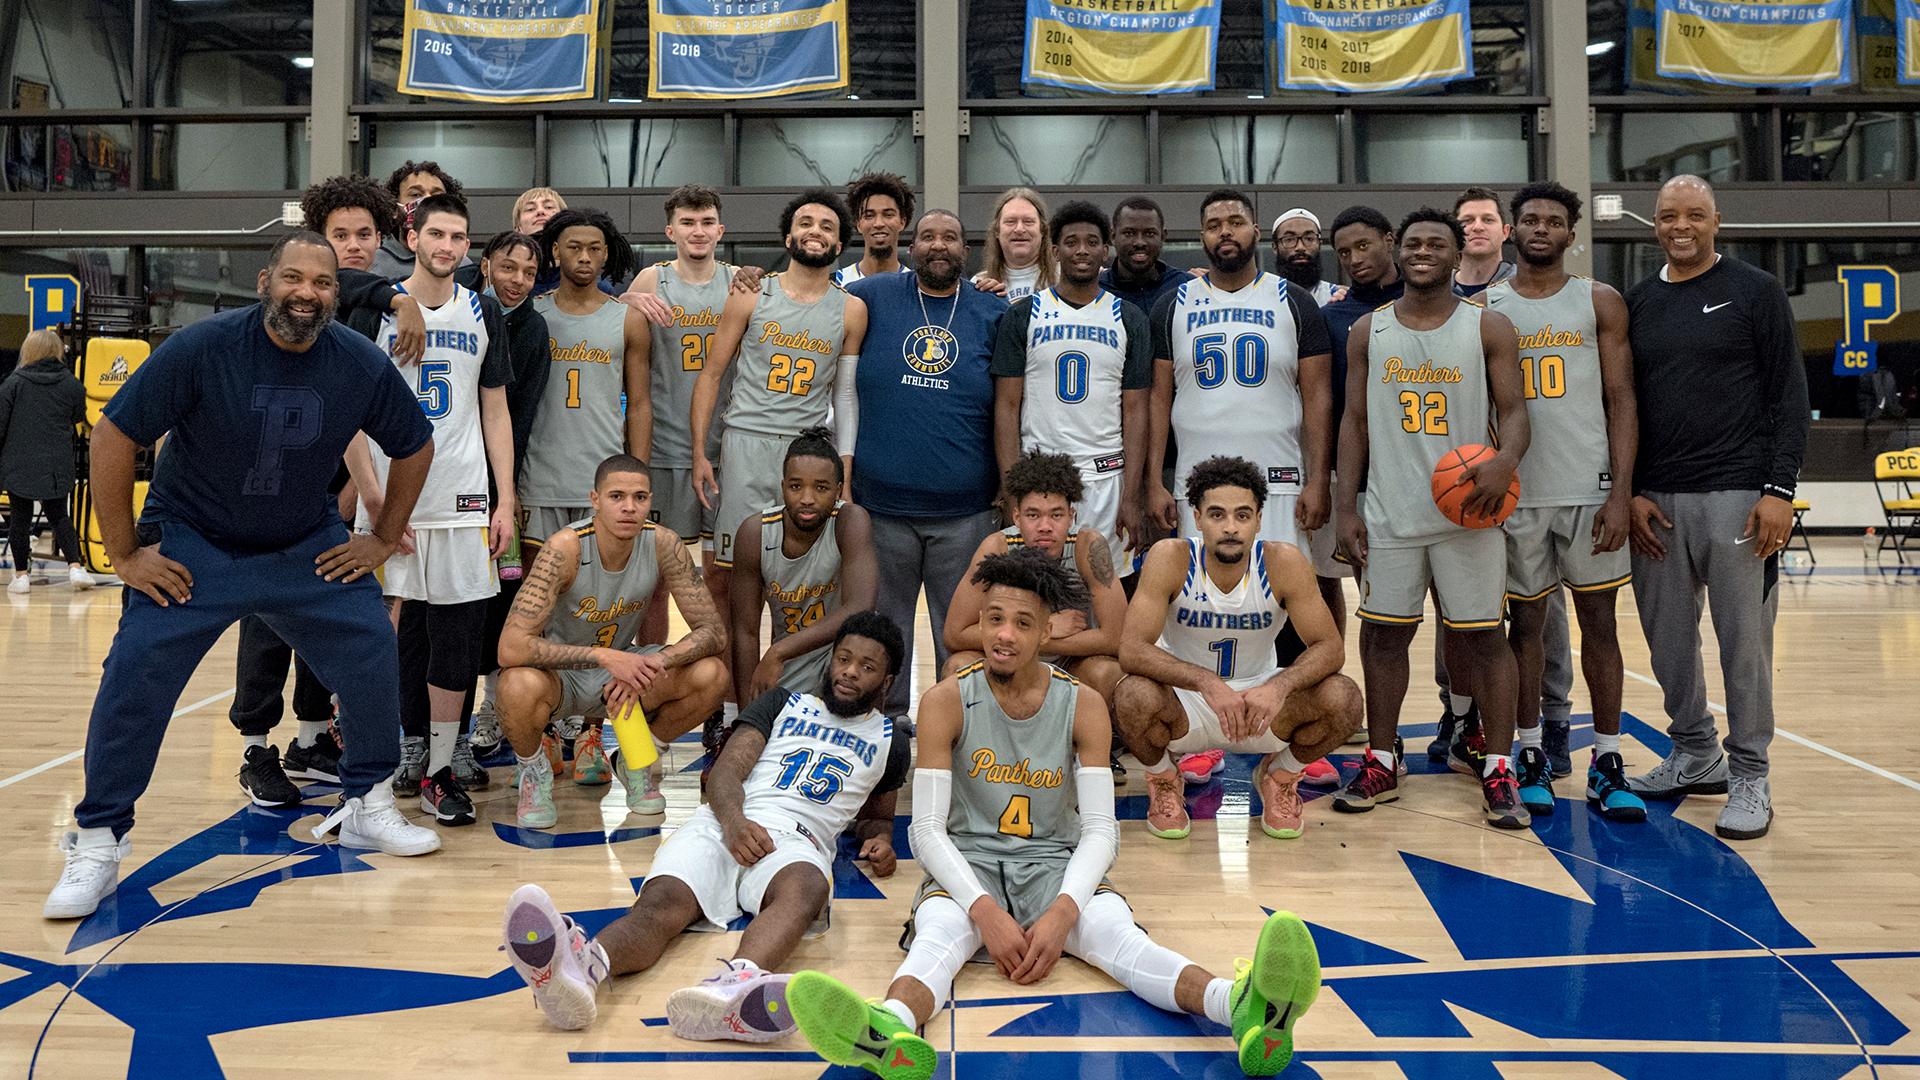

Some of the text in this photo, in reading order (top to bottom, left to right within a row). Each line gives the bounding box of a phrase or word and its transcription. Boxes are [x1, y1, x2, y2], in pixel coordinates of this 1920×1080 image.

[447, 3, 557, 18] BASKETBALL
[714, 2, 780, 15] SOCCER
[1051, 6, 1194, 28] REGION CHAMPIONS
[1302, 11, 1371, 27] TOURNAMENT
[1678, 0, 1826, 21] REGION CHAMPIONS
[419, 14, 584, 35] TOURNAMENT APPEARANCES
[676, 12, 820, 32] PLAYOFF APPEARANCES
[1678, 23, 1705, 38] 2017
[424, 39, 453, 56] 2015
[1046, 30, 1073, 45] 2014
[1300, 36, 1369, 53] 2014 2017
[672, 43, 701, 57] 2018
[1045, 52, 1072, 67] 2018
[1301, 56, 1370, 74] 2016 2018
[667, 305, 723, 328] Panthe
[1837, 265, 1901, 346] P
[1186, 308, 1275, 334] PANTHERS
[388, 329, 479, 357] THERS
[759, 321, 833, 355] Panthers
[1031, 324, 1119, 349] PANTHERS
[1513, 324, 1584, 350] anthers
[906, 353, 952, 373] COMMUNITY
[1193, 332, 1269, 390] 50
[1382, 357, 1463, 384] Panthers
[1844, 351, 1868, 368] CC
[766, 353, 816, 396] 22
[901, 374, 949, 390] ATHLETICS
[1055, 350, 1090, 404] 0
[1519, 354, 1567, 400] 10
[417, 360, 452, 421] 5
[566, 369, 581, 408] 1
[1399, 390, 1448, 436] 32
[1886, 456, 1917, 470] PCC
[720, 532, 732, 556] P
[768, 579, 838, 603] Panthers
[571, 596, 648, 624] Panthers
[1176, 606, 1273, 631] PANTHERS
[1208, 637, 1238, 680] 1
[776, 716, 879, 769] PANTHERS
[771, 746, 855, 806] 15
[967, 747, 1065, 789] Panthers
[997, 794, 1034, 840] 4
